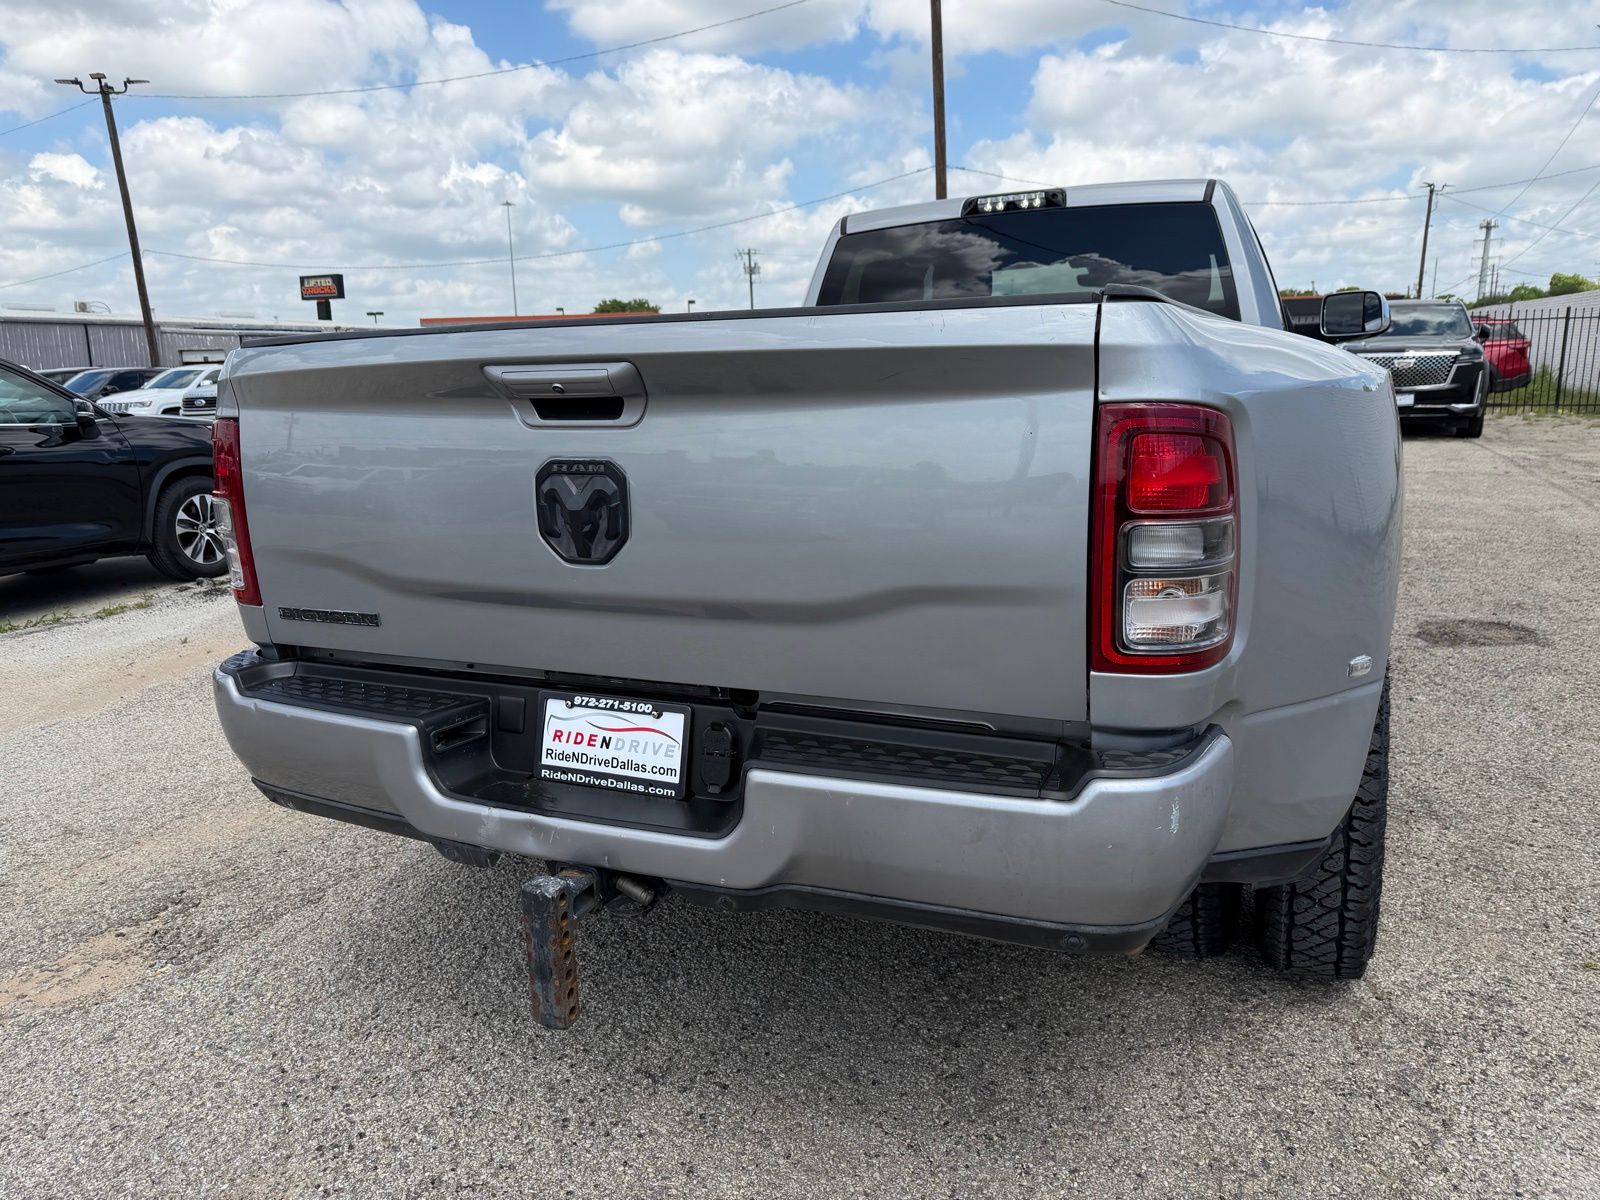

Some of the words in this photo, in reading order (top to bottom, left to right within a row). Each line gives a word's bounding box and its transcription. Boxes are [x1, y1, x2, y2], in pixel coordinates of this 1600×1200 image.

[551, 463, 605, 472] RAM
[573, 696, 653, 713] 972-271-5100
[545, 748, 677, 777] RideNDriveDallas.com
[541, 769, 675, 797] RideNDriveDallas.com
